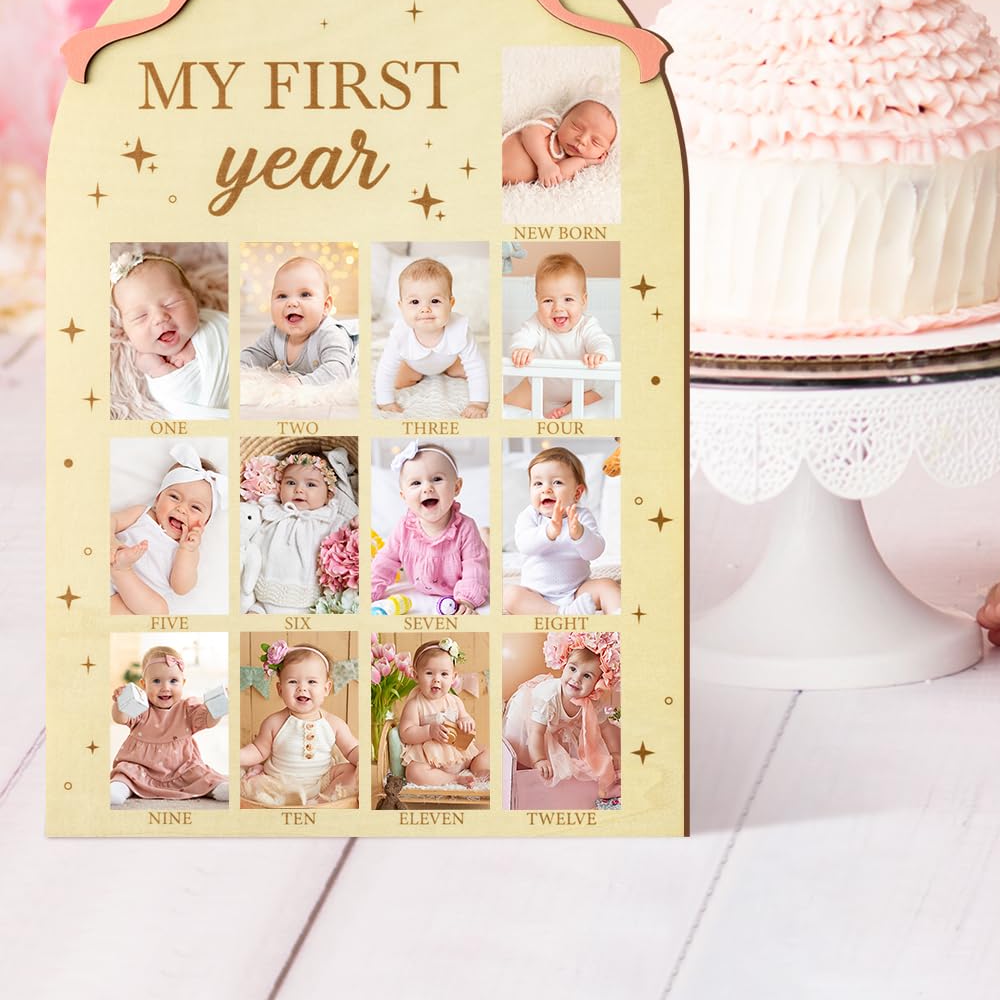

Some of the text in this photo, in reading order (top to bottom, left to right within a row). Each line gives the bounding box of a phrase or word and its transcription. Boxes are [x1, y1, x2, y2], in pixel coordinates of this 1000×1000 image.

[137, 60, 460, 111] MY FIRST
[207, 128, 391, 217] year
[514, 226, 607, 240] NEW BORN
[150, 421, 188, 435] ONE
[277, 421, 319, 435] TWO
[402, 421, 460, 435] THREE
[537, 421, 585, 435] FOUR
[151, 616, 189, 630] FIVE
[284, 616, 312, 630] SIX
[404, 616, 458, 630] SEVEN
[534, 616, 589, 631] EIGHT
[148, 811, 193, 825] NINE
[281, 811, 317, 826] TEN
[399, 811, 465, 826] ELEVEN
[526, 811, 597, 826] TWELVE
